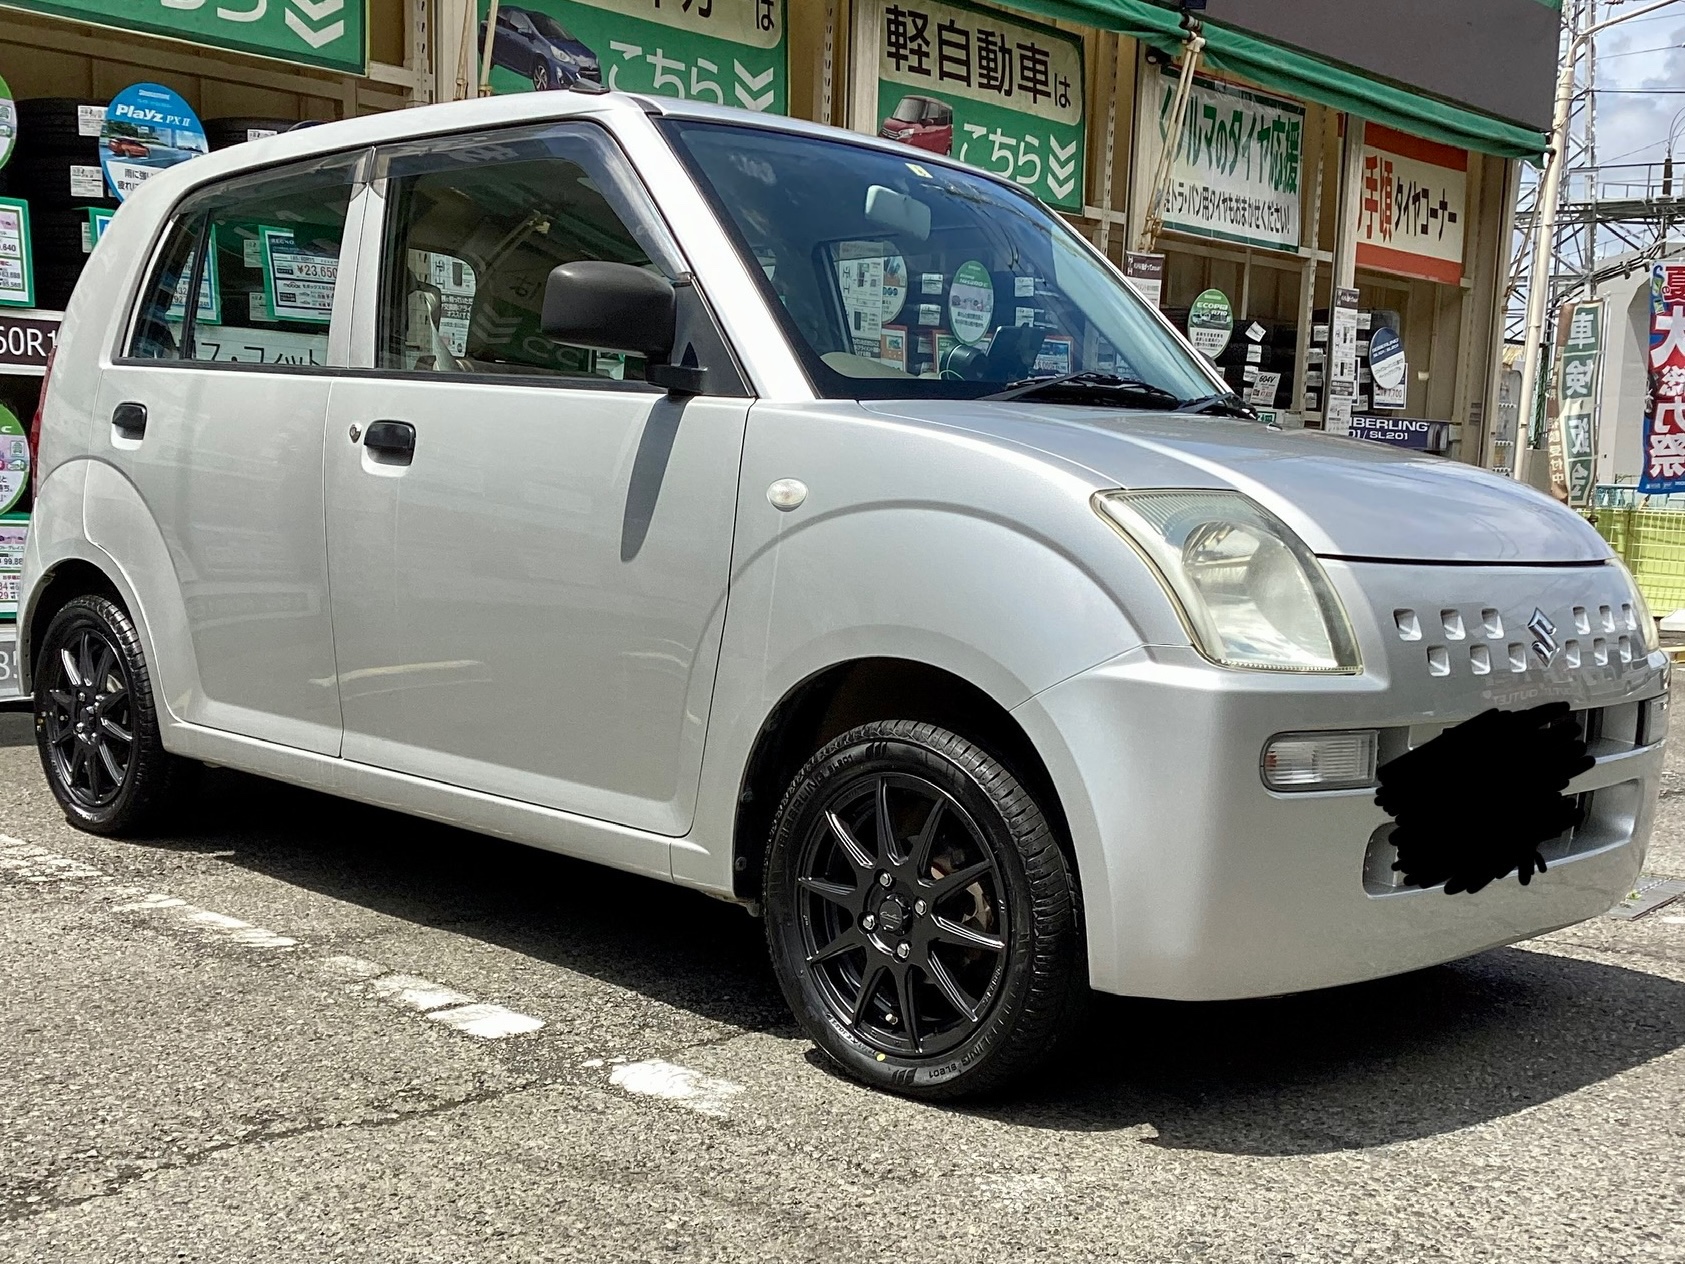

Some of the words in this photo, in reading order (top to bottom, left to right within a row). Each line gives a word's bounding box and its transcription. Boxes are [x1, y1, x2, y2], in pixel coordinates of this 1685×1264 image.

[608, 40, 725, 105] こちら
[885, 4, 1071, 109] 軽自動車は
[115, 103, 163, 122] Playz
[959, 123, 1042, 185] こちら
[1369, 430, 1408, 440] SL201
